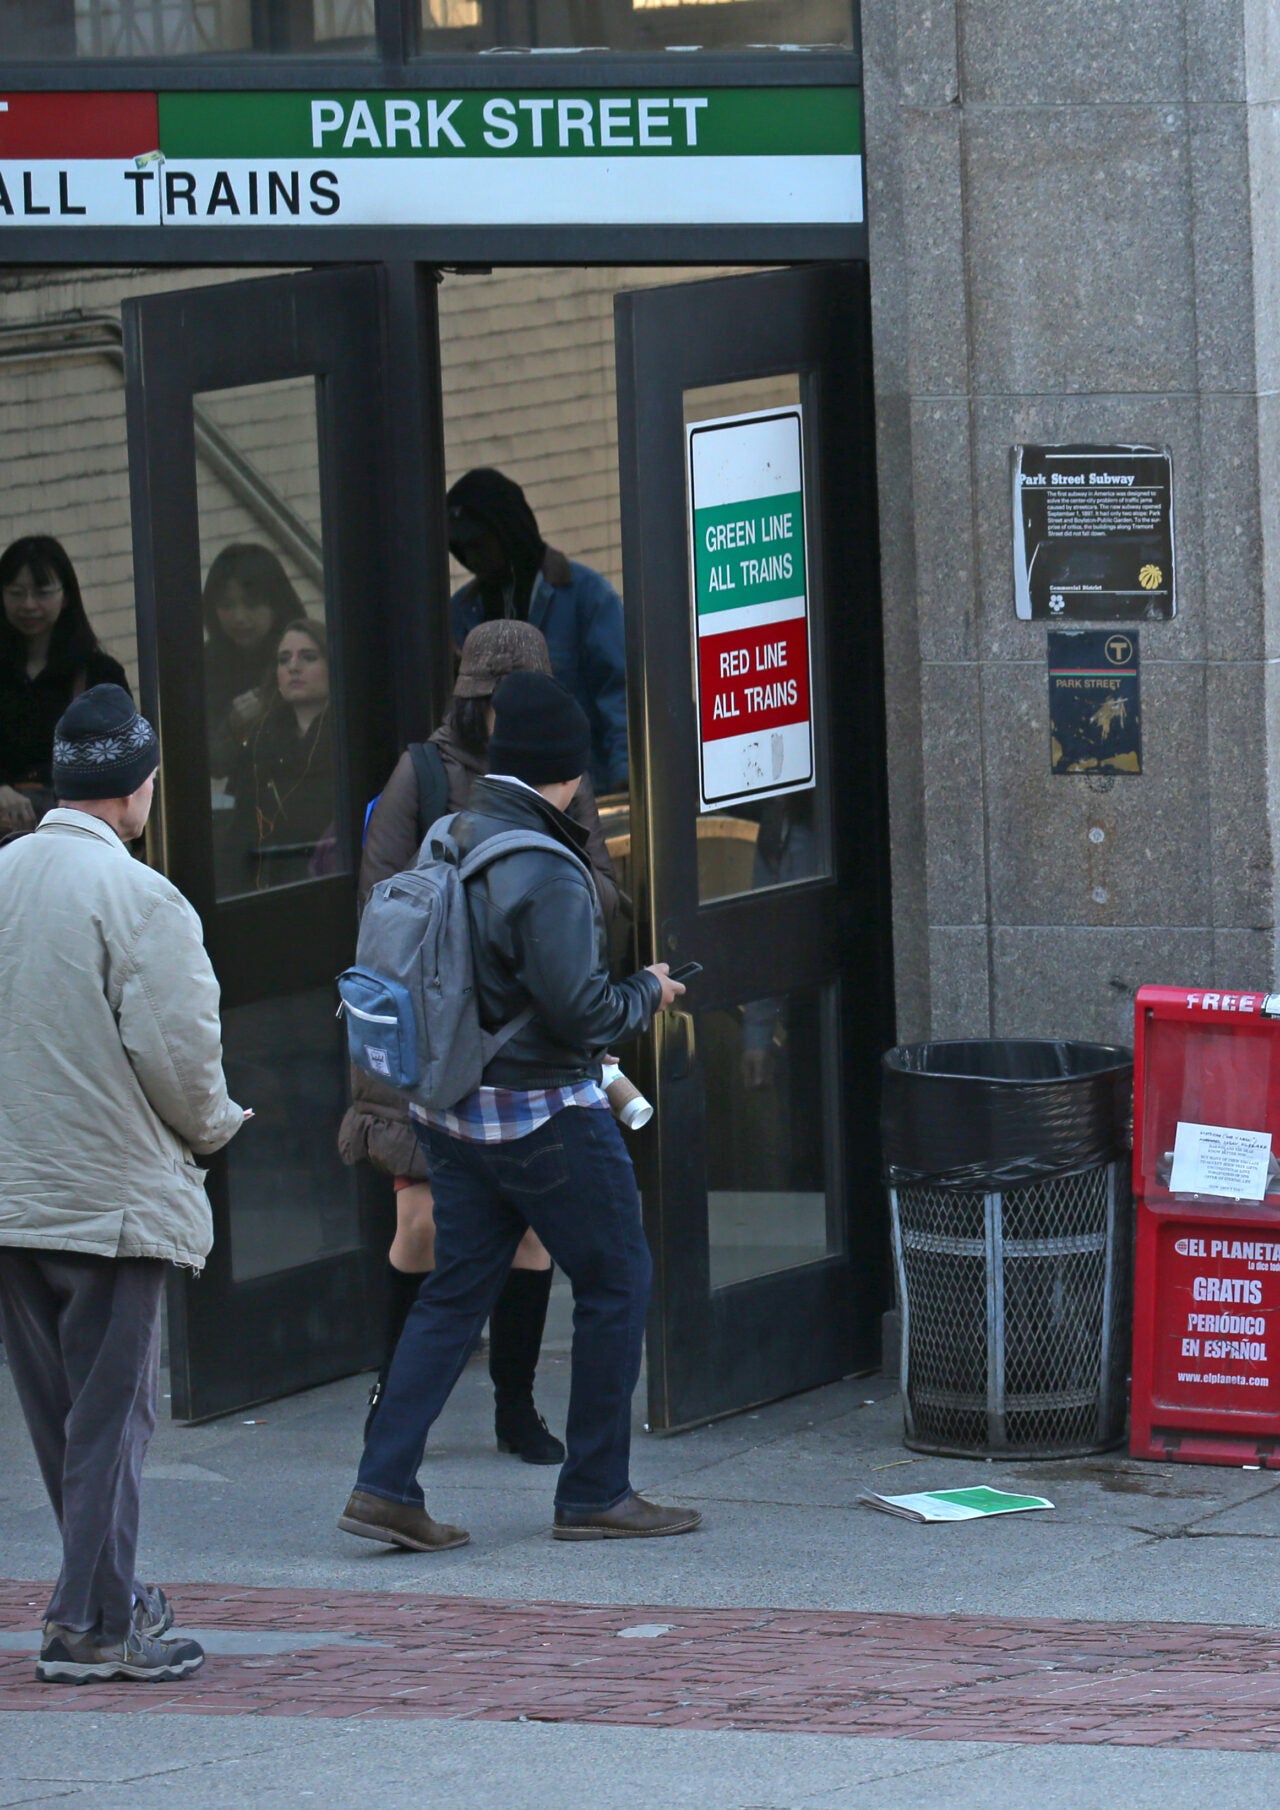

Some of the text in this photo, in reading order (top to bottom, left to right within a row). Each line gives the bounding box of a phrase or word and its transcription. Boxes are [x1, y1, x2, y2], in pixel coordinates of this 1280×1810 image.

[310, 97, 708, 149] PARK STREET
[125, 169, 343, 216] TRAINS
[1019, 473, 1135, 487] Park Street Subway
[706, 512, 794, 552] GREEN LINE
[708, 552, 794, 593] ALL TRAINS
[719, 640, 788, 679] RED LINE
[1109, 642, 1128, 660] T
[1055, 679, 1122, 689] PARK STREET
[713, 678, 798, 721] ALL TRAINS
[1186, 992, 1256, 1012] FREE
[1193, 1276, 1263, 1305] GRATIS
[1187, 1311, 1266, 1336] PERIÓDICO
[1181, 1338, 1268, 1361] EN ESPAÑOL
[1177, 1372, 1270, 1387] www.elplaneta.com
